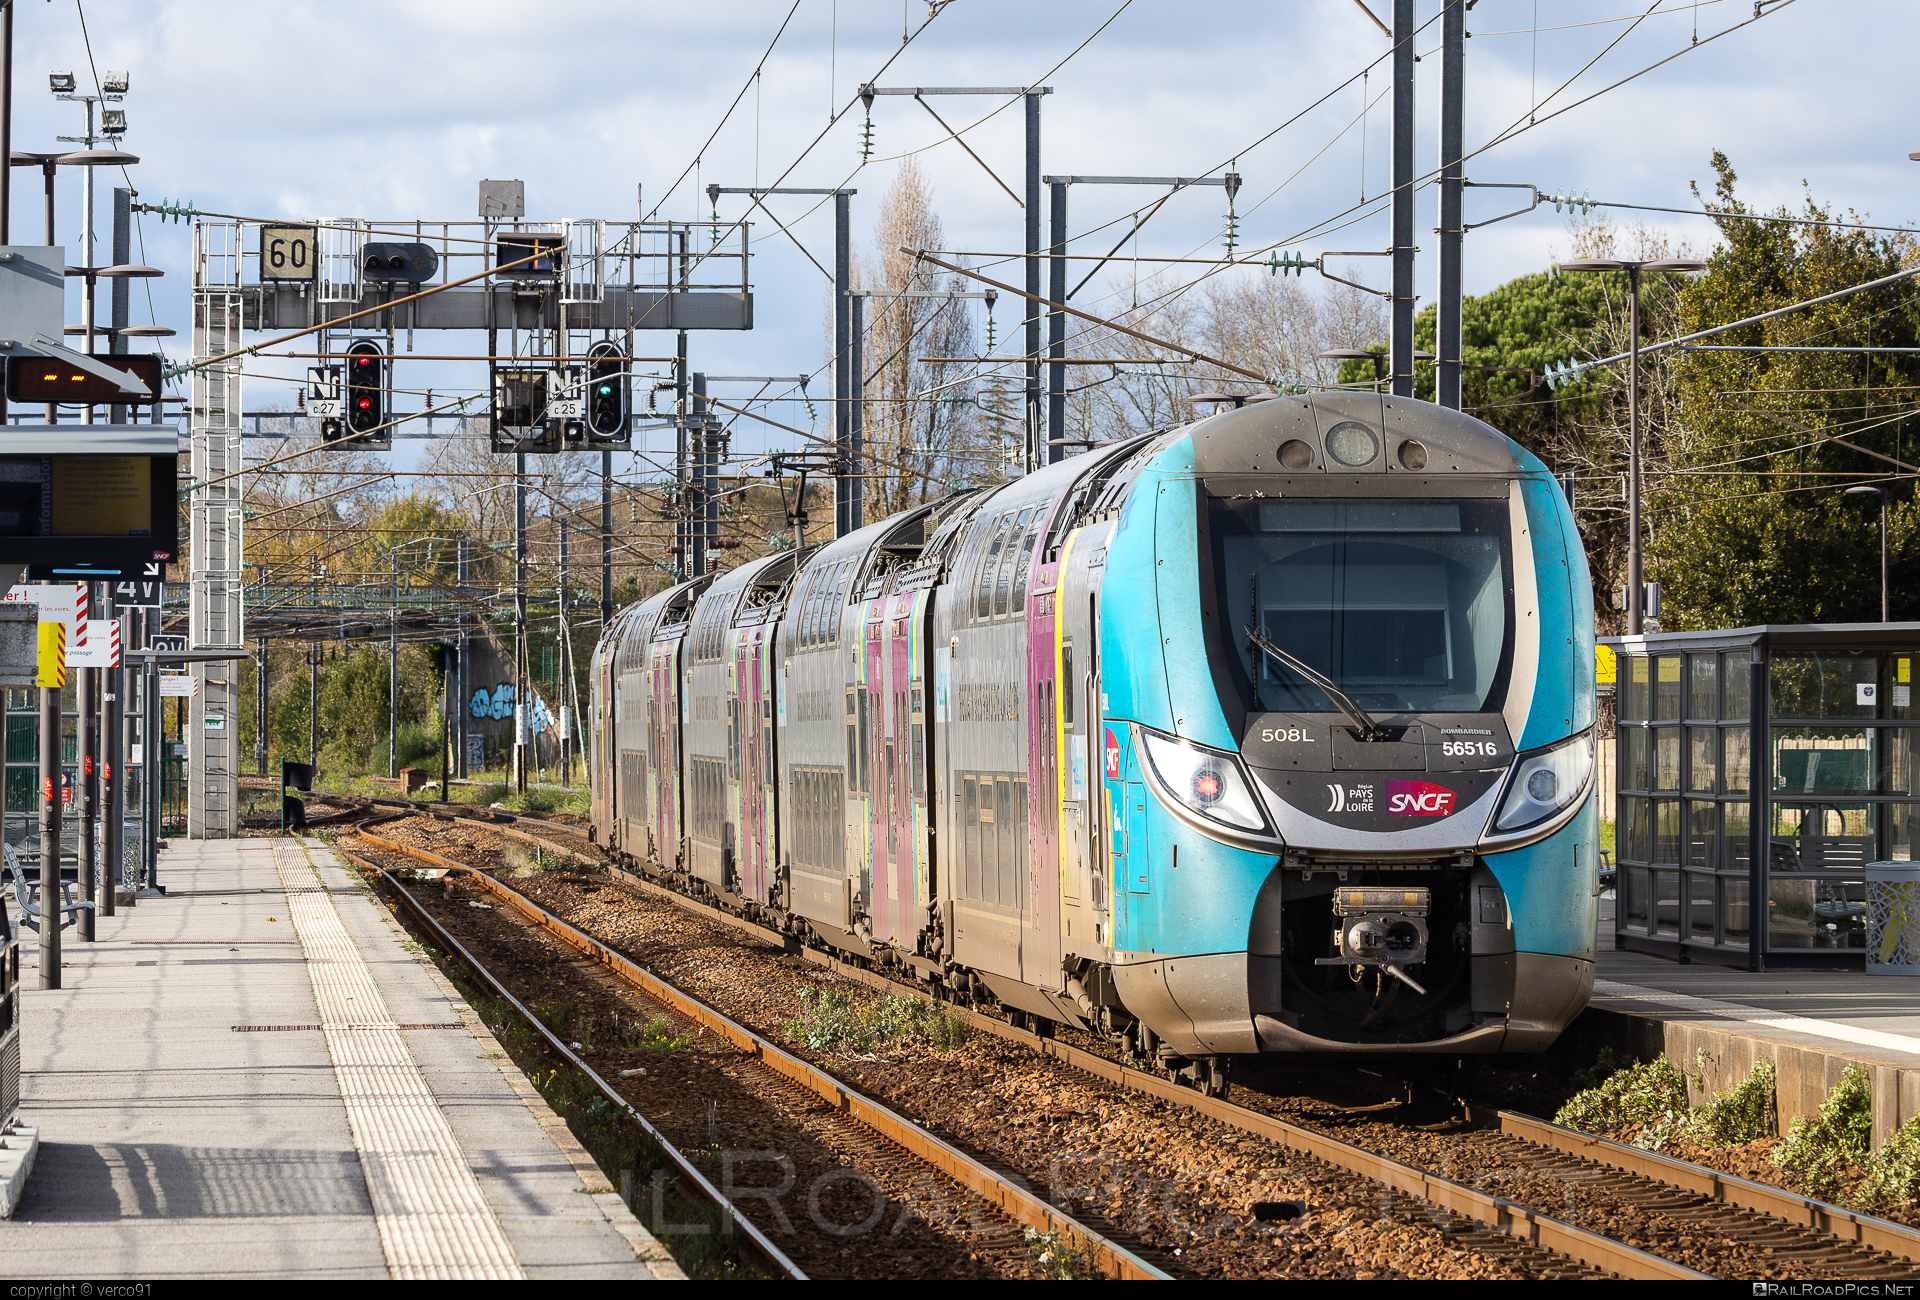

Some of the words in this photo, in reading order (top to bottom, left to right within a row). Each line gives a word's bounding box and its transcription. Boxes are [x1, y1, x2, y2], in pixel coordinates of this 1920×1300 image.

[271, 239, 306, 268] 60
[308, 369, 340, 398] Nr
[313, 402, 335, 414] c.27
[554, 403, 576, 415] c.25
[1261, 728, 1315, 743] 508L
[1440, 728, 1493, 736] BOMBARDIER
[1442, 741, 1498, 756] 56516
[1349, 789, 1373, 799] PAYS
[1346, 802, 1374, 812] LOIRE
[1388, 793, 1452, 812] SNCF
